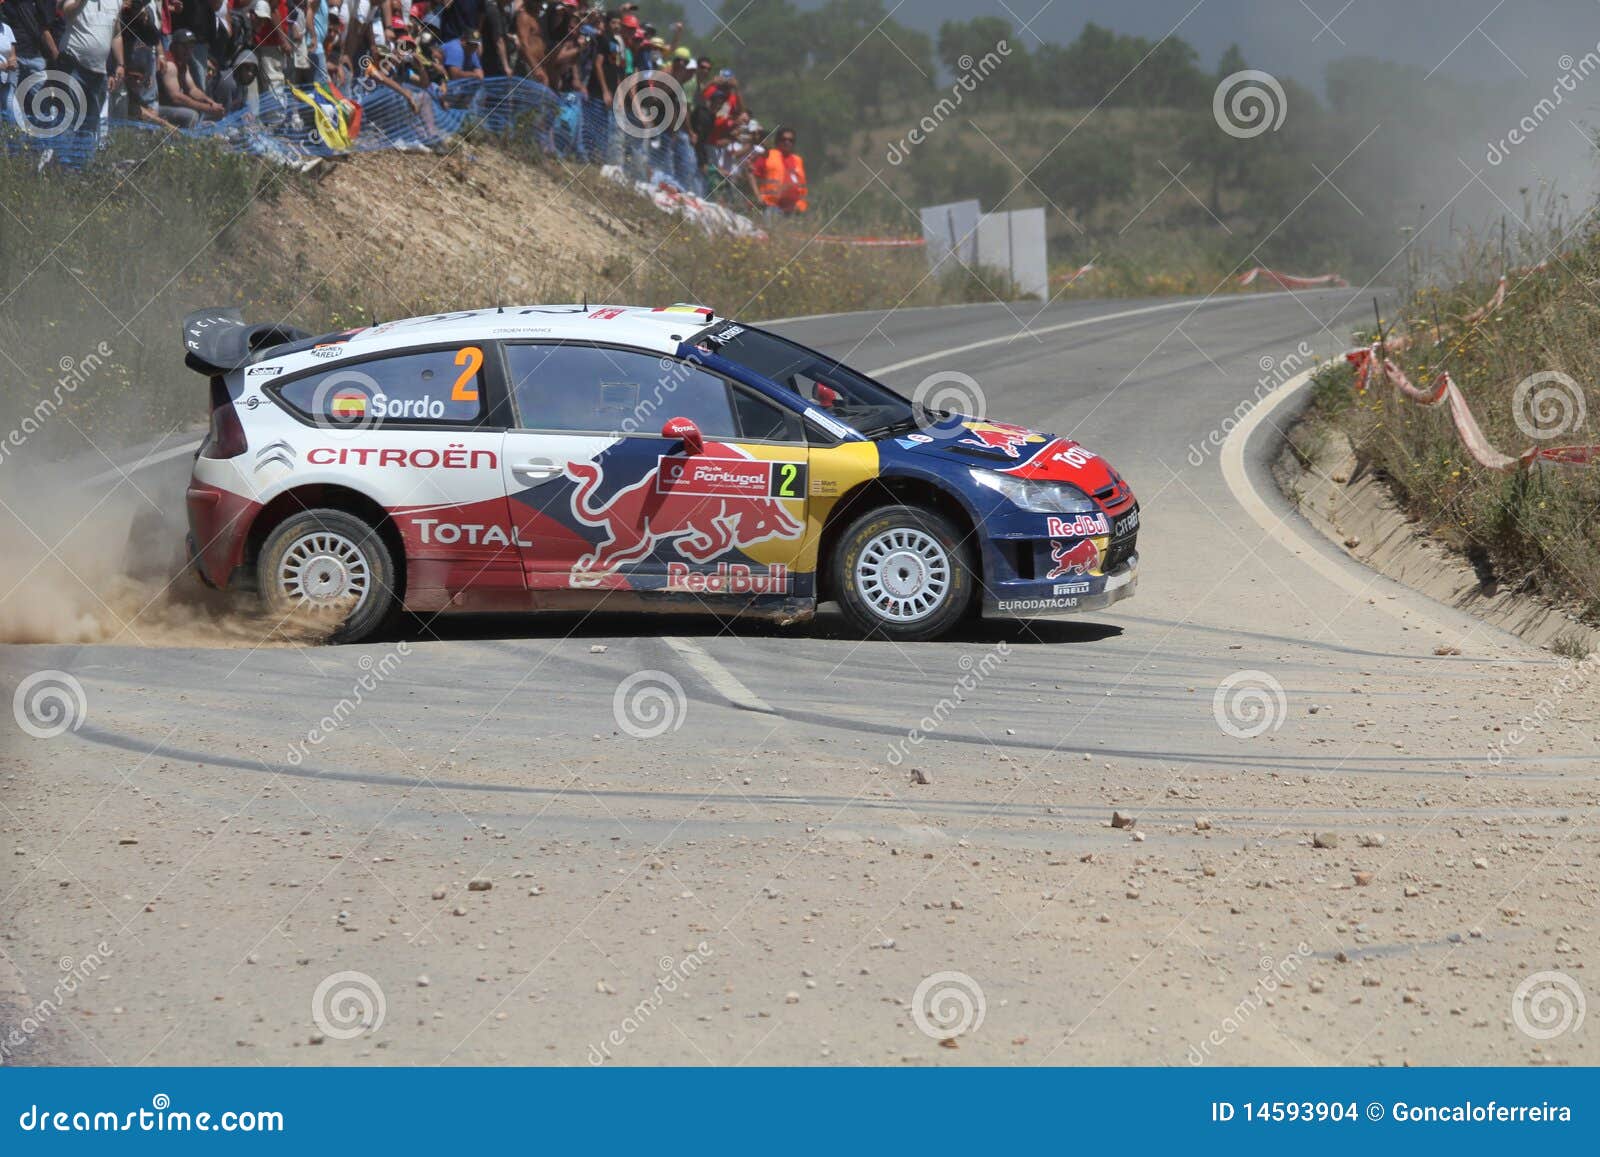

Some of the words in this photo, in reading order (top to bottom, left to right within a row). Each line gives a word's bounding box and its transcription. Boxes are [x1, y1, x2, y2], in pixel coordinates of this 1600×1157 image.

[451, 347, 483, 400] 2
[371, 394, 444, 418] Sordo
[694, 470, 766, 484] Portugal
[779, 464, 797, 496] 2
[411, 518, 532, 547] TOTAL
[1053, 582, 1089, 595] PIRELLI
[998, 598, 1078, 610] EURODATACAR
